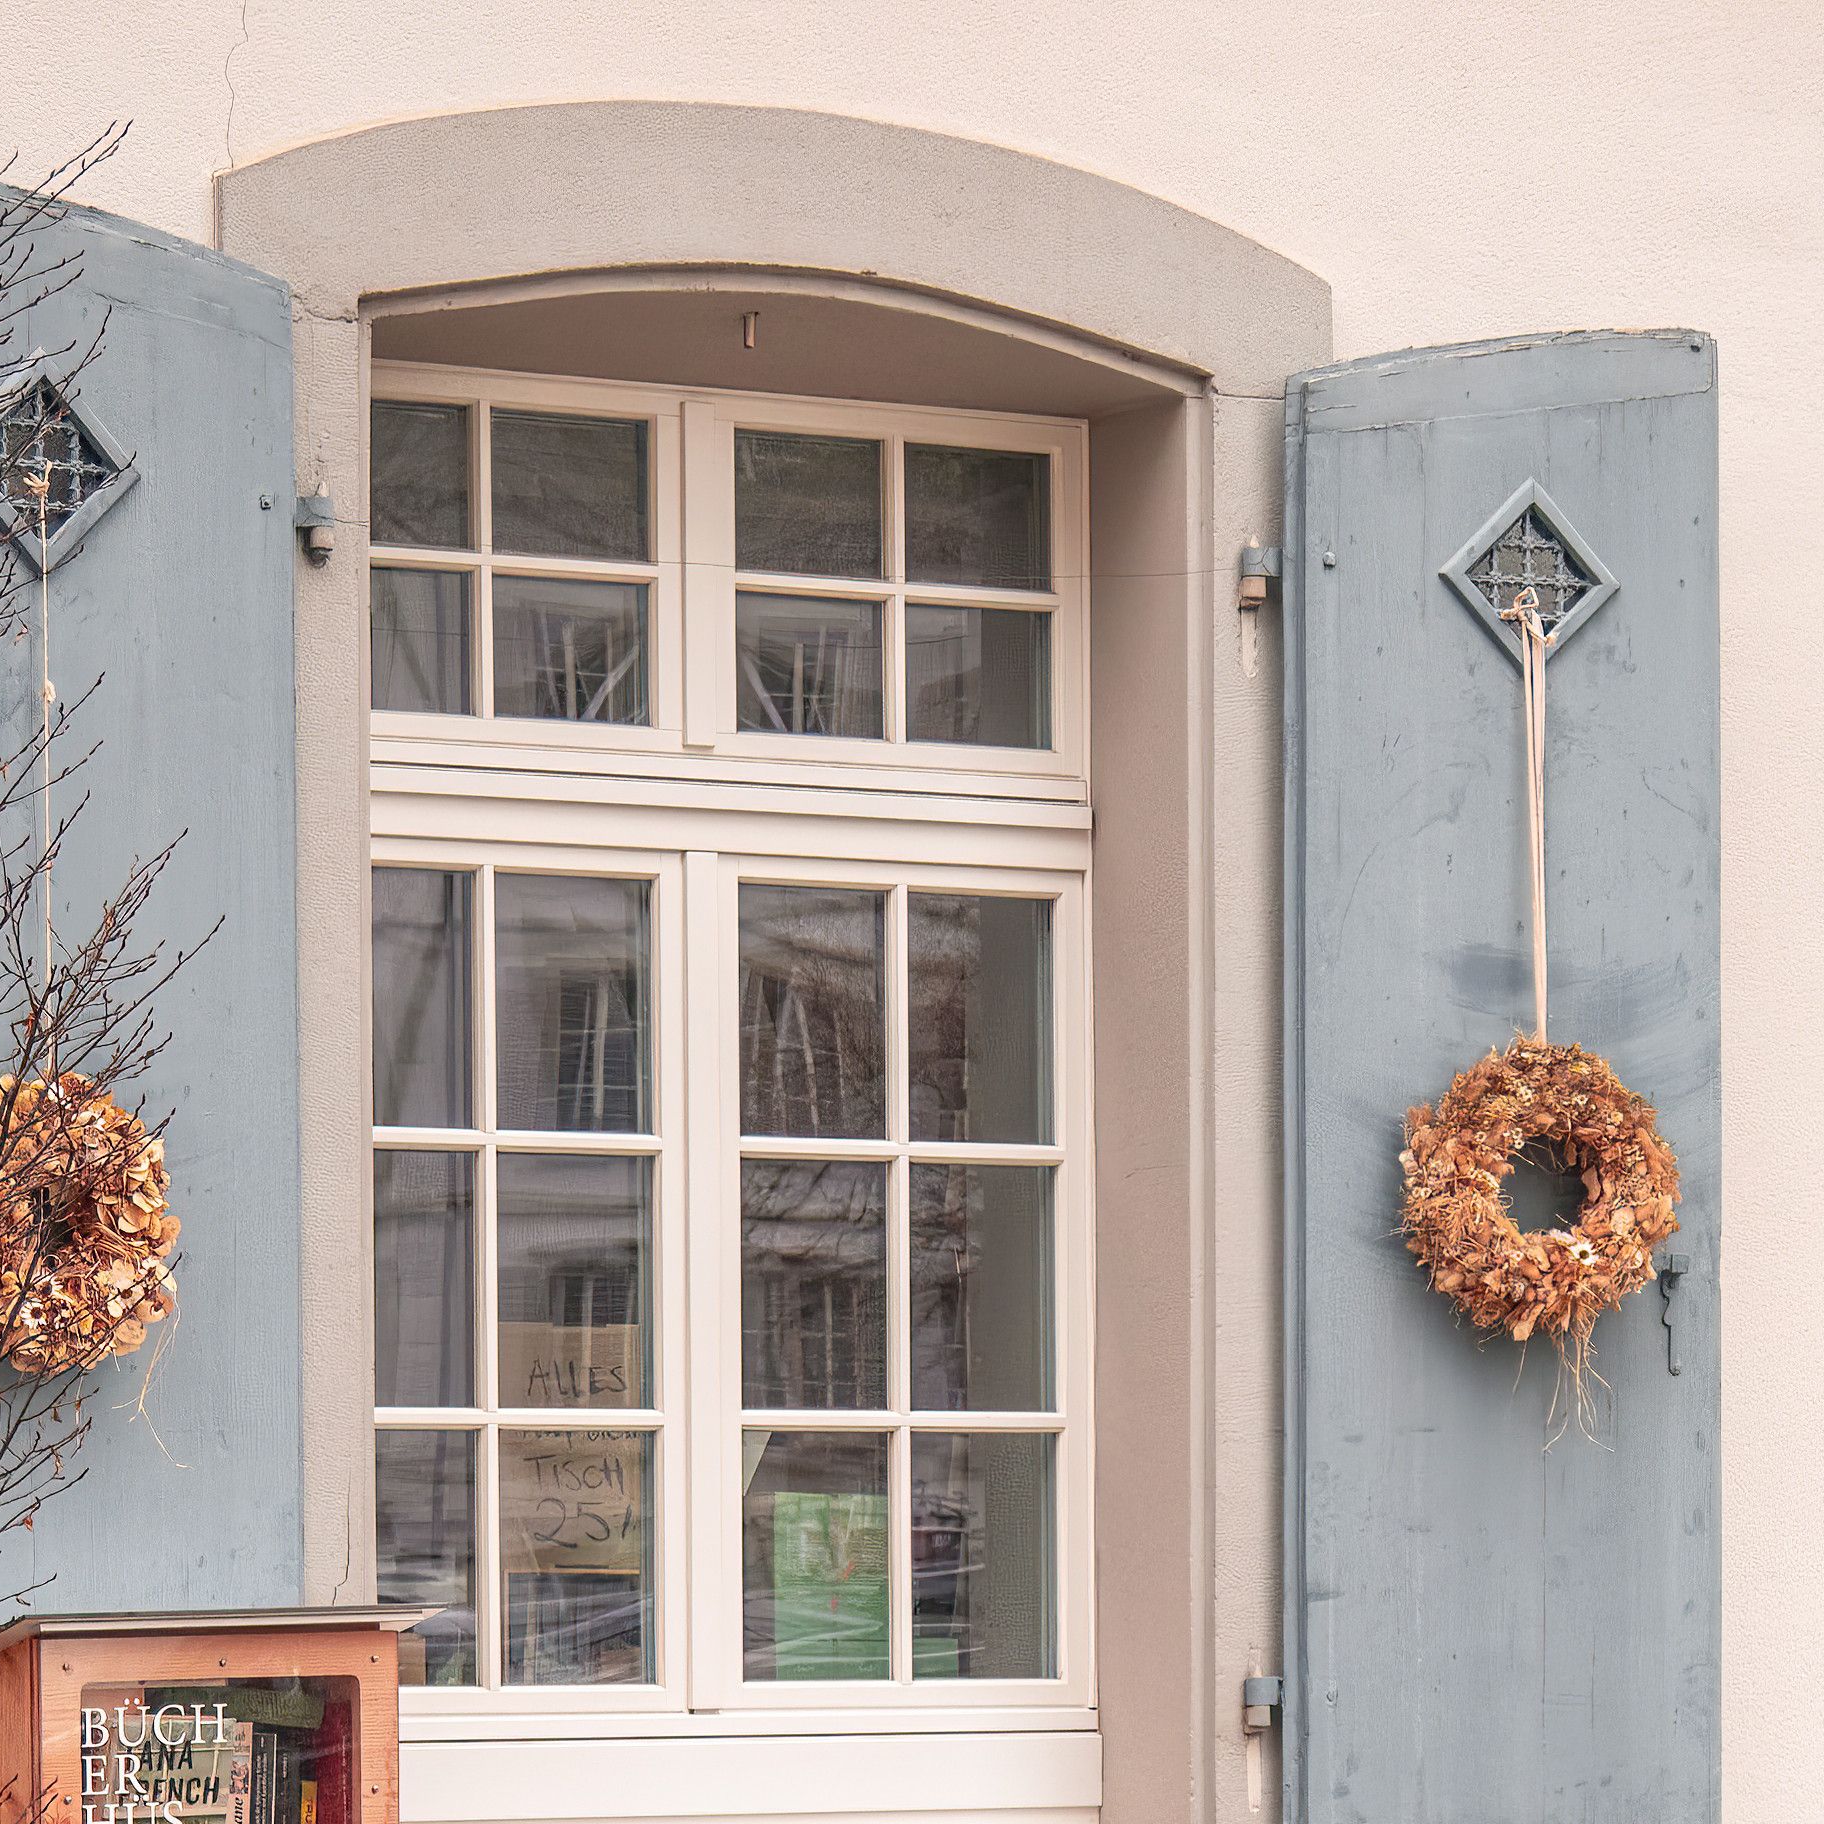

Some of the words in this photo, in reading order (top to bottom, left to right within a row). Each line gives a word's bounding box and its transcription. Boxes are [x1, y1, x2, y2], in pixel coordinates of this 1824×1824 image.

[528, 1357, 626, 1398] ALLES
[523, 1453, 625, 1496] TISCH
[81, 1697, 228, 1749] BÜCH
[81, 1753, 148, 1797] ER
